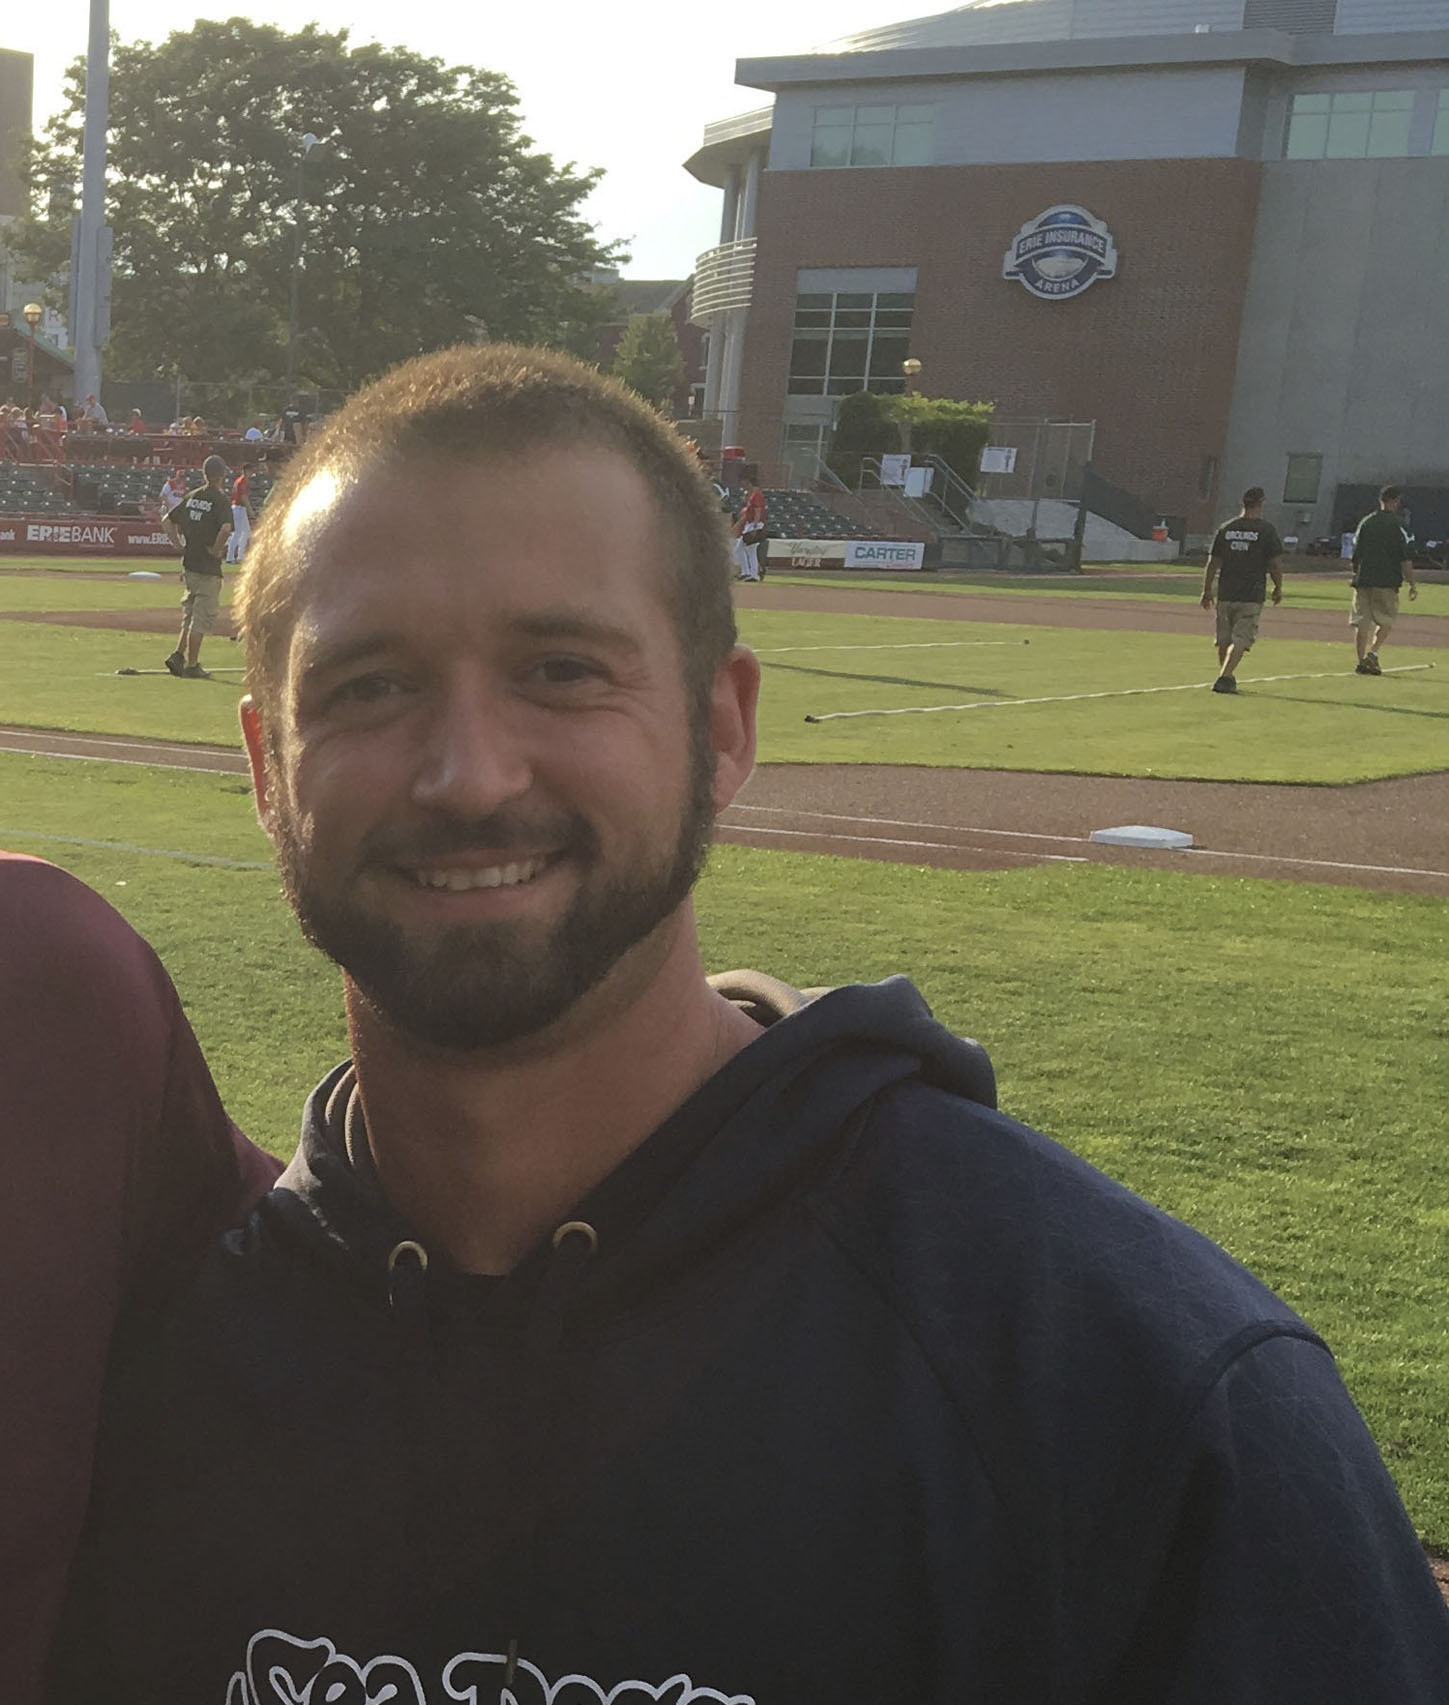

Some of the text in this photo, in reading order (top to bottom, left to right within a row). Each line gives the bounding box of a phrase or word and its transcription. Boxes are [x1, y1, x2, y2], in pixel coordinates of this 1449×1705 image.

[1018, 230, 1105, 254] ERIE INSURANCE
[1035, 279, 1080, 293] ARENA
[26, 524, 115, 544] ERIEBANK
[854, 546, 916, 561] CARTER
